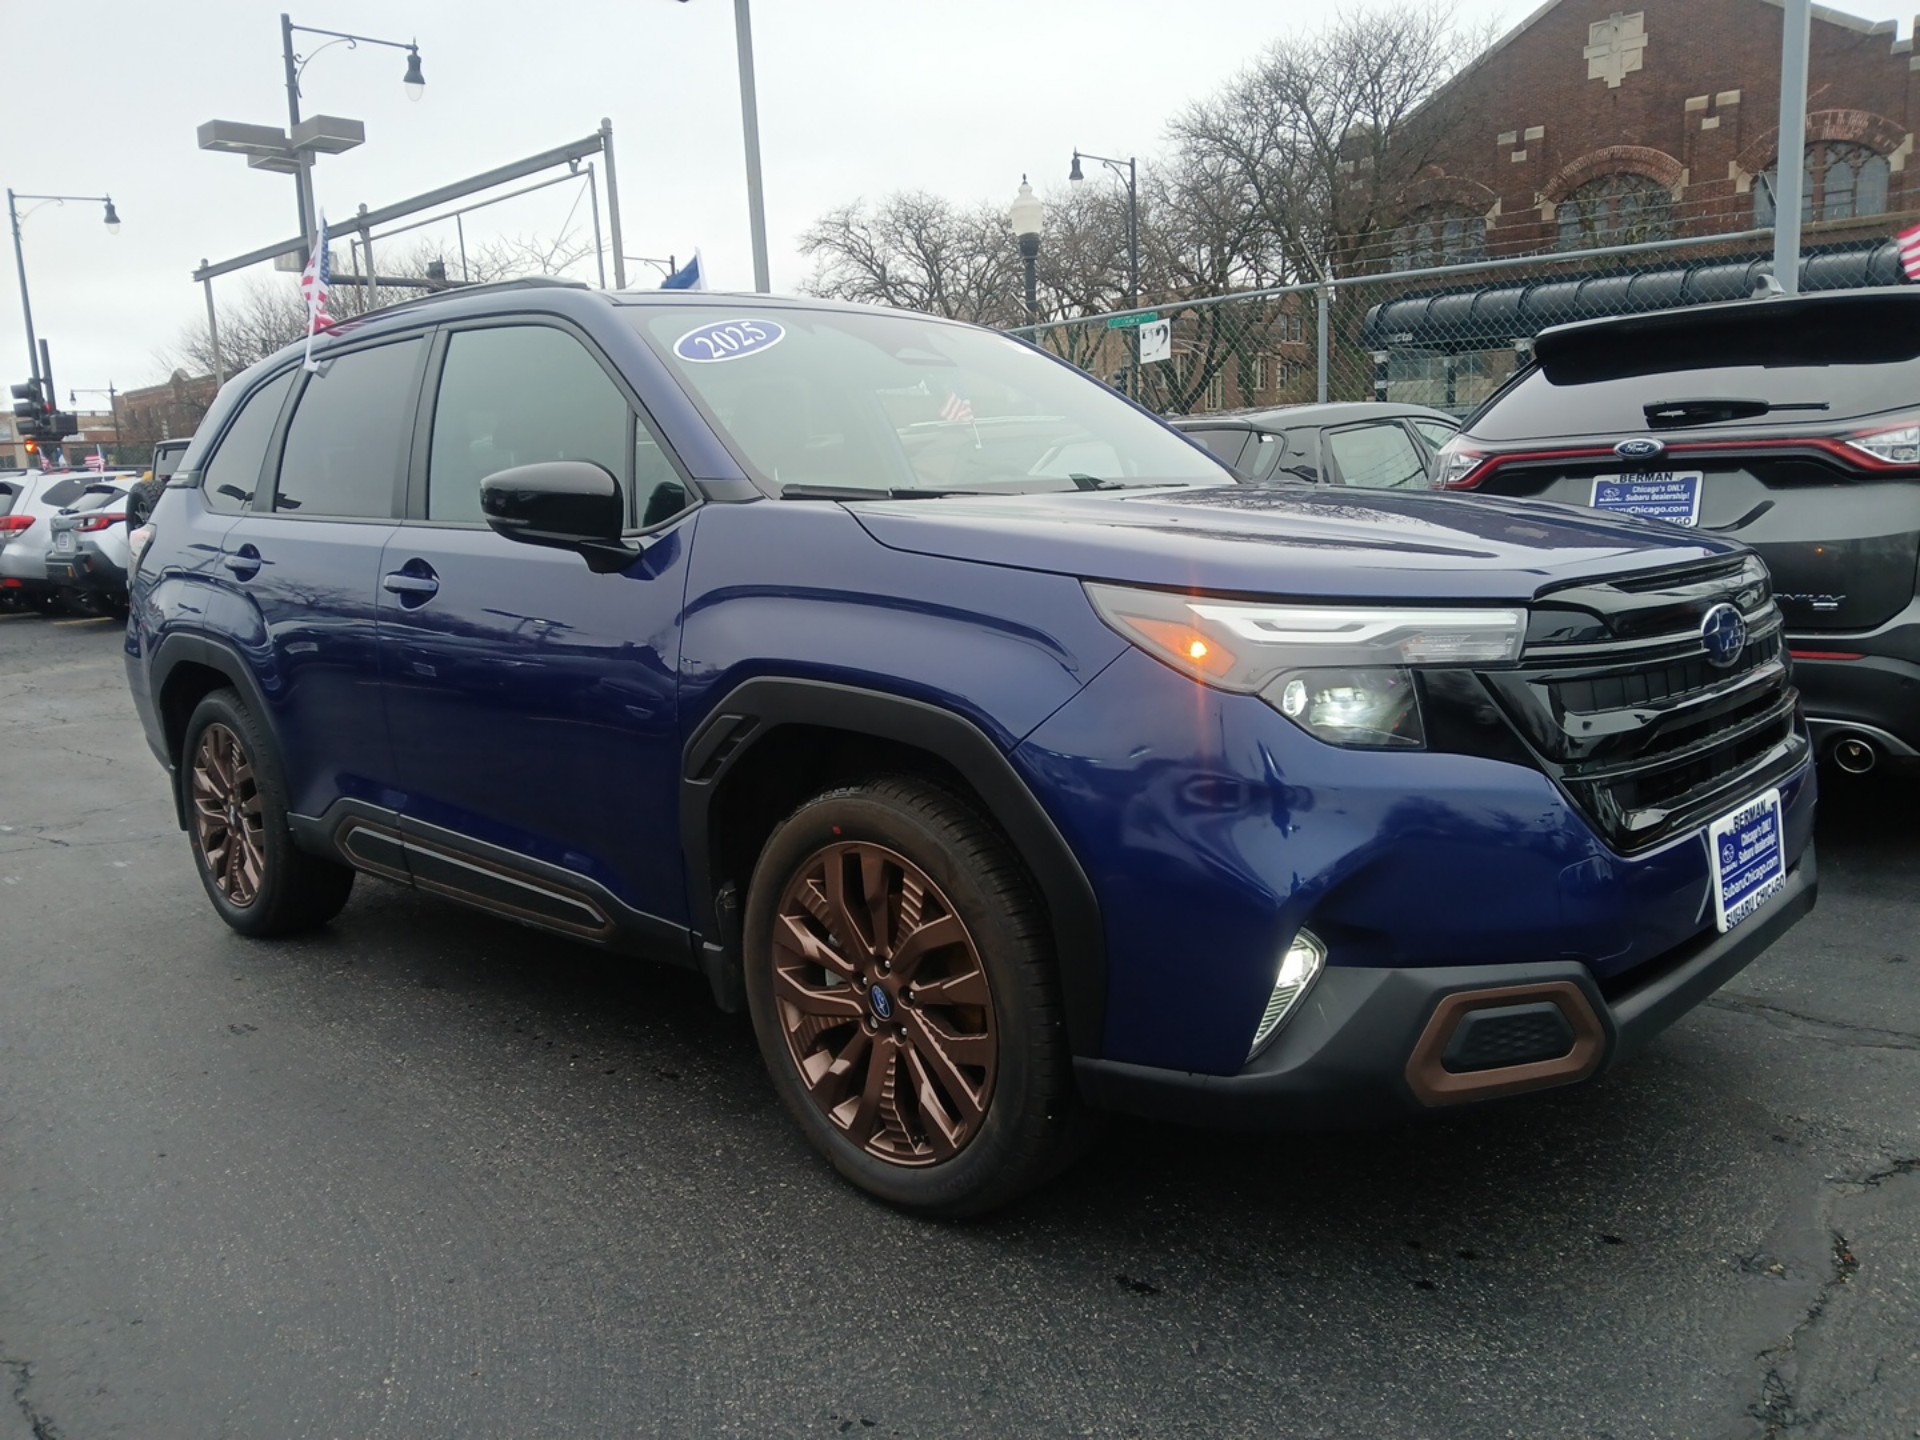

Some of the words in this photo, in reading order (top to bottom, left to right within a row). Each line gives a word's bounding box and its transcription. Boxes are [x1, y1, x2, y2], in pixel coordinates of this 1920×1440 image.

[694, 321, 767, 358] 2025
[1624, 442, 1650, 453] Ford
[1620, 472, 1673, 483] BERMAN
[1625, 493, 1650, 502] Subaru
[1651, 492, 1690, 501] dealership!
[1632, 485, 1665, 494] Chicago's
[1667, 484, 1685, 492] ONLY
[1733, 799, 1766, 830] BERMAN
[1723, 855, 1778, 901] SubaruChicago.com
[1726, 895, 1755, 930] SUBARU
[1756, 874, 1784, 907] CHICAGO
